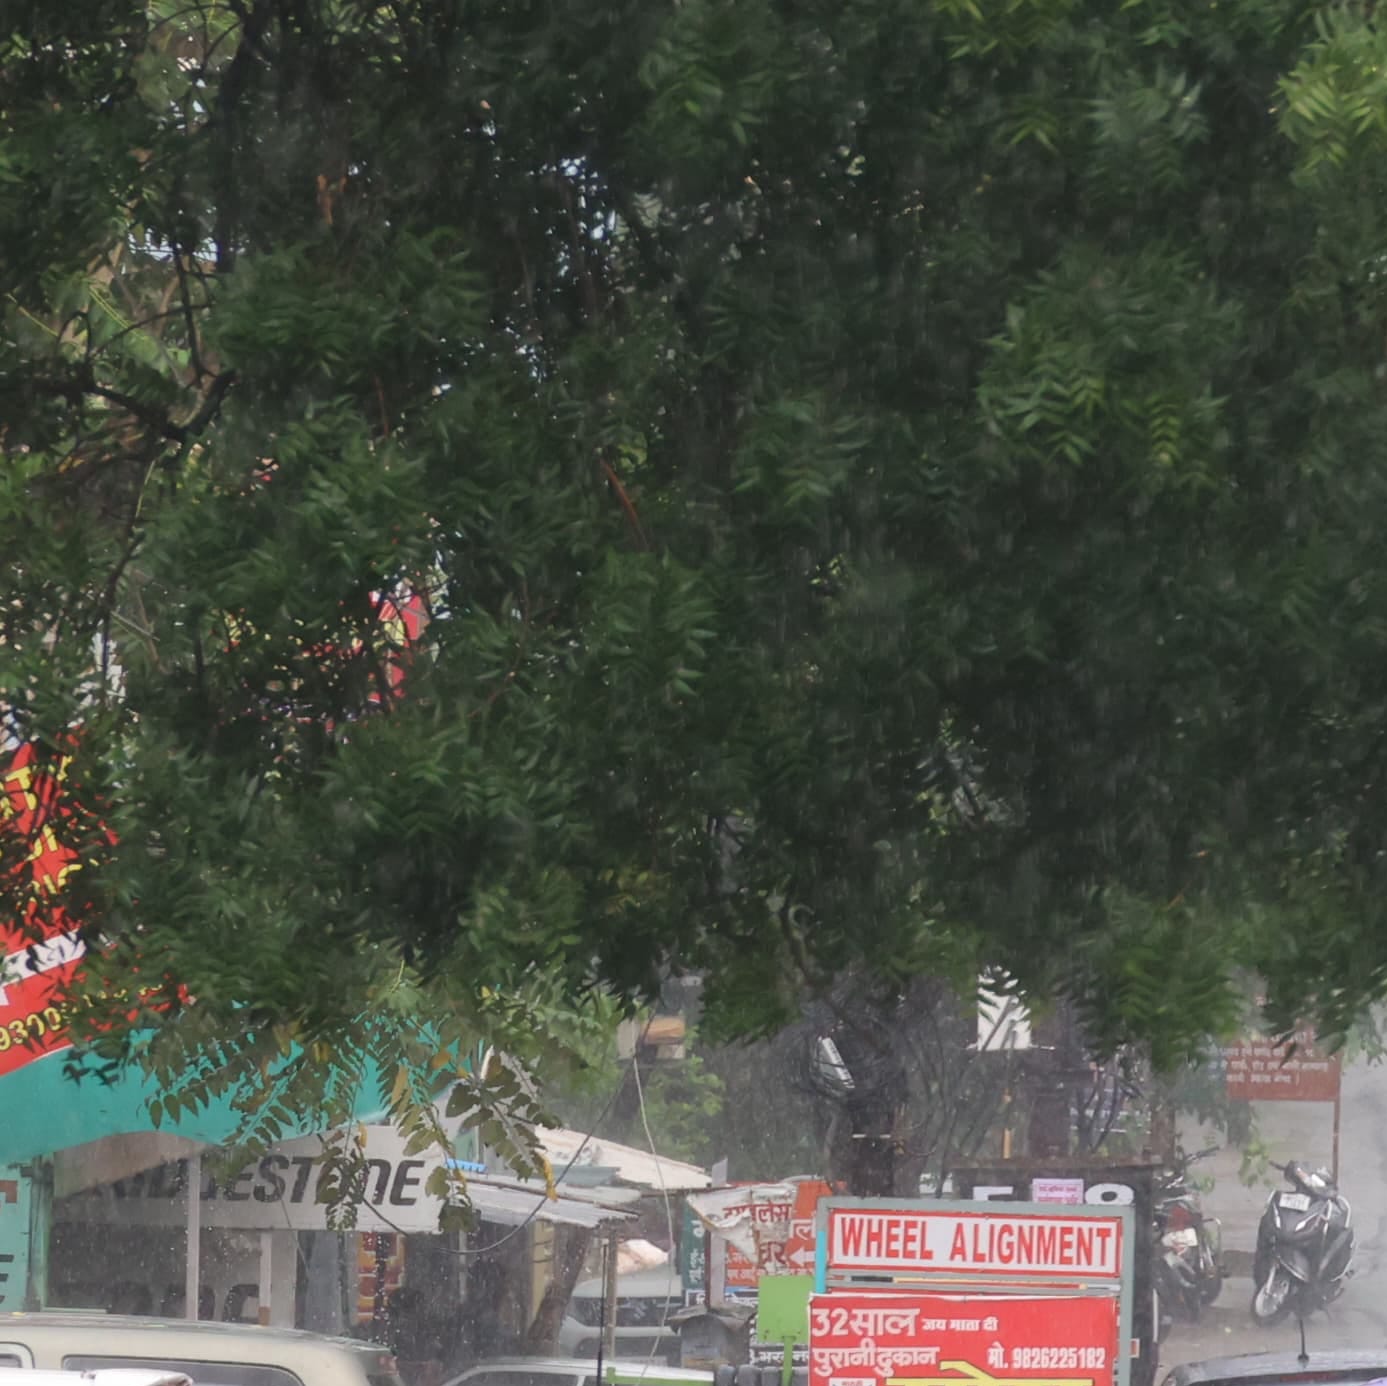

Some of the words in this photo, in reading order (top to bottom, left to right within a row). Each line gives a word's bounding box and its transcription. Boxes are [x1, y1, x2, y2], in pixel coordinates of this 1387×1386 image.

[841, 1216, 933, 1260] WHEEL
[950, 1222, 1112, 1267] ALIGNMENT
[1012, 1347, 1105, 1369] 9826225182
